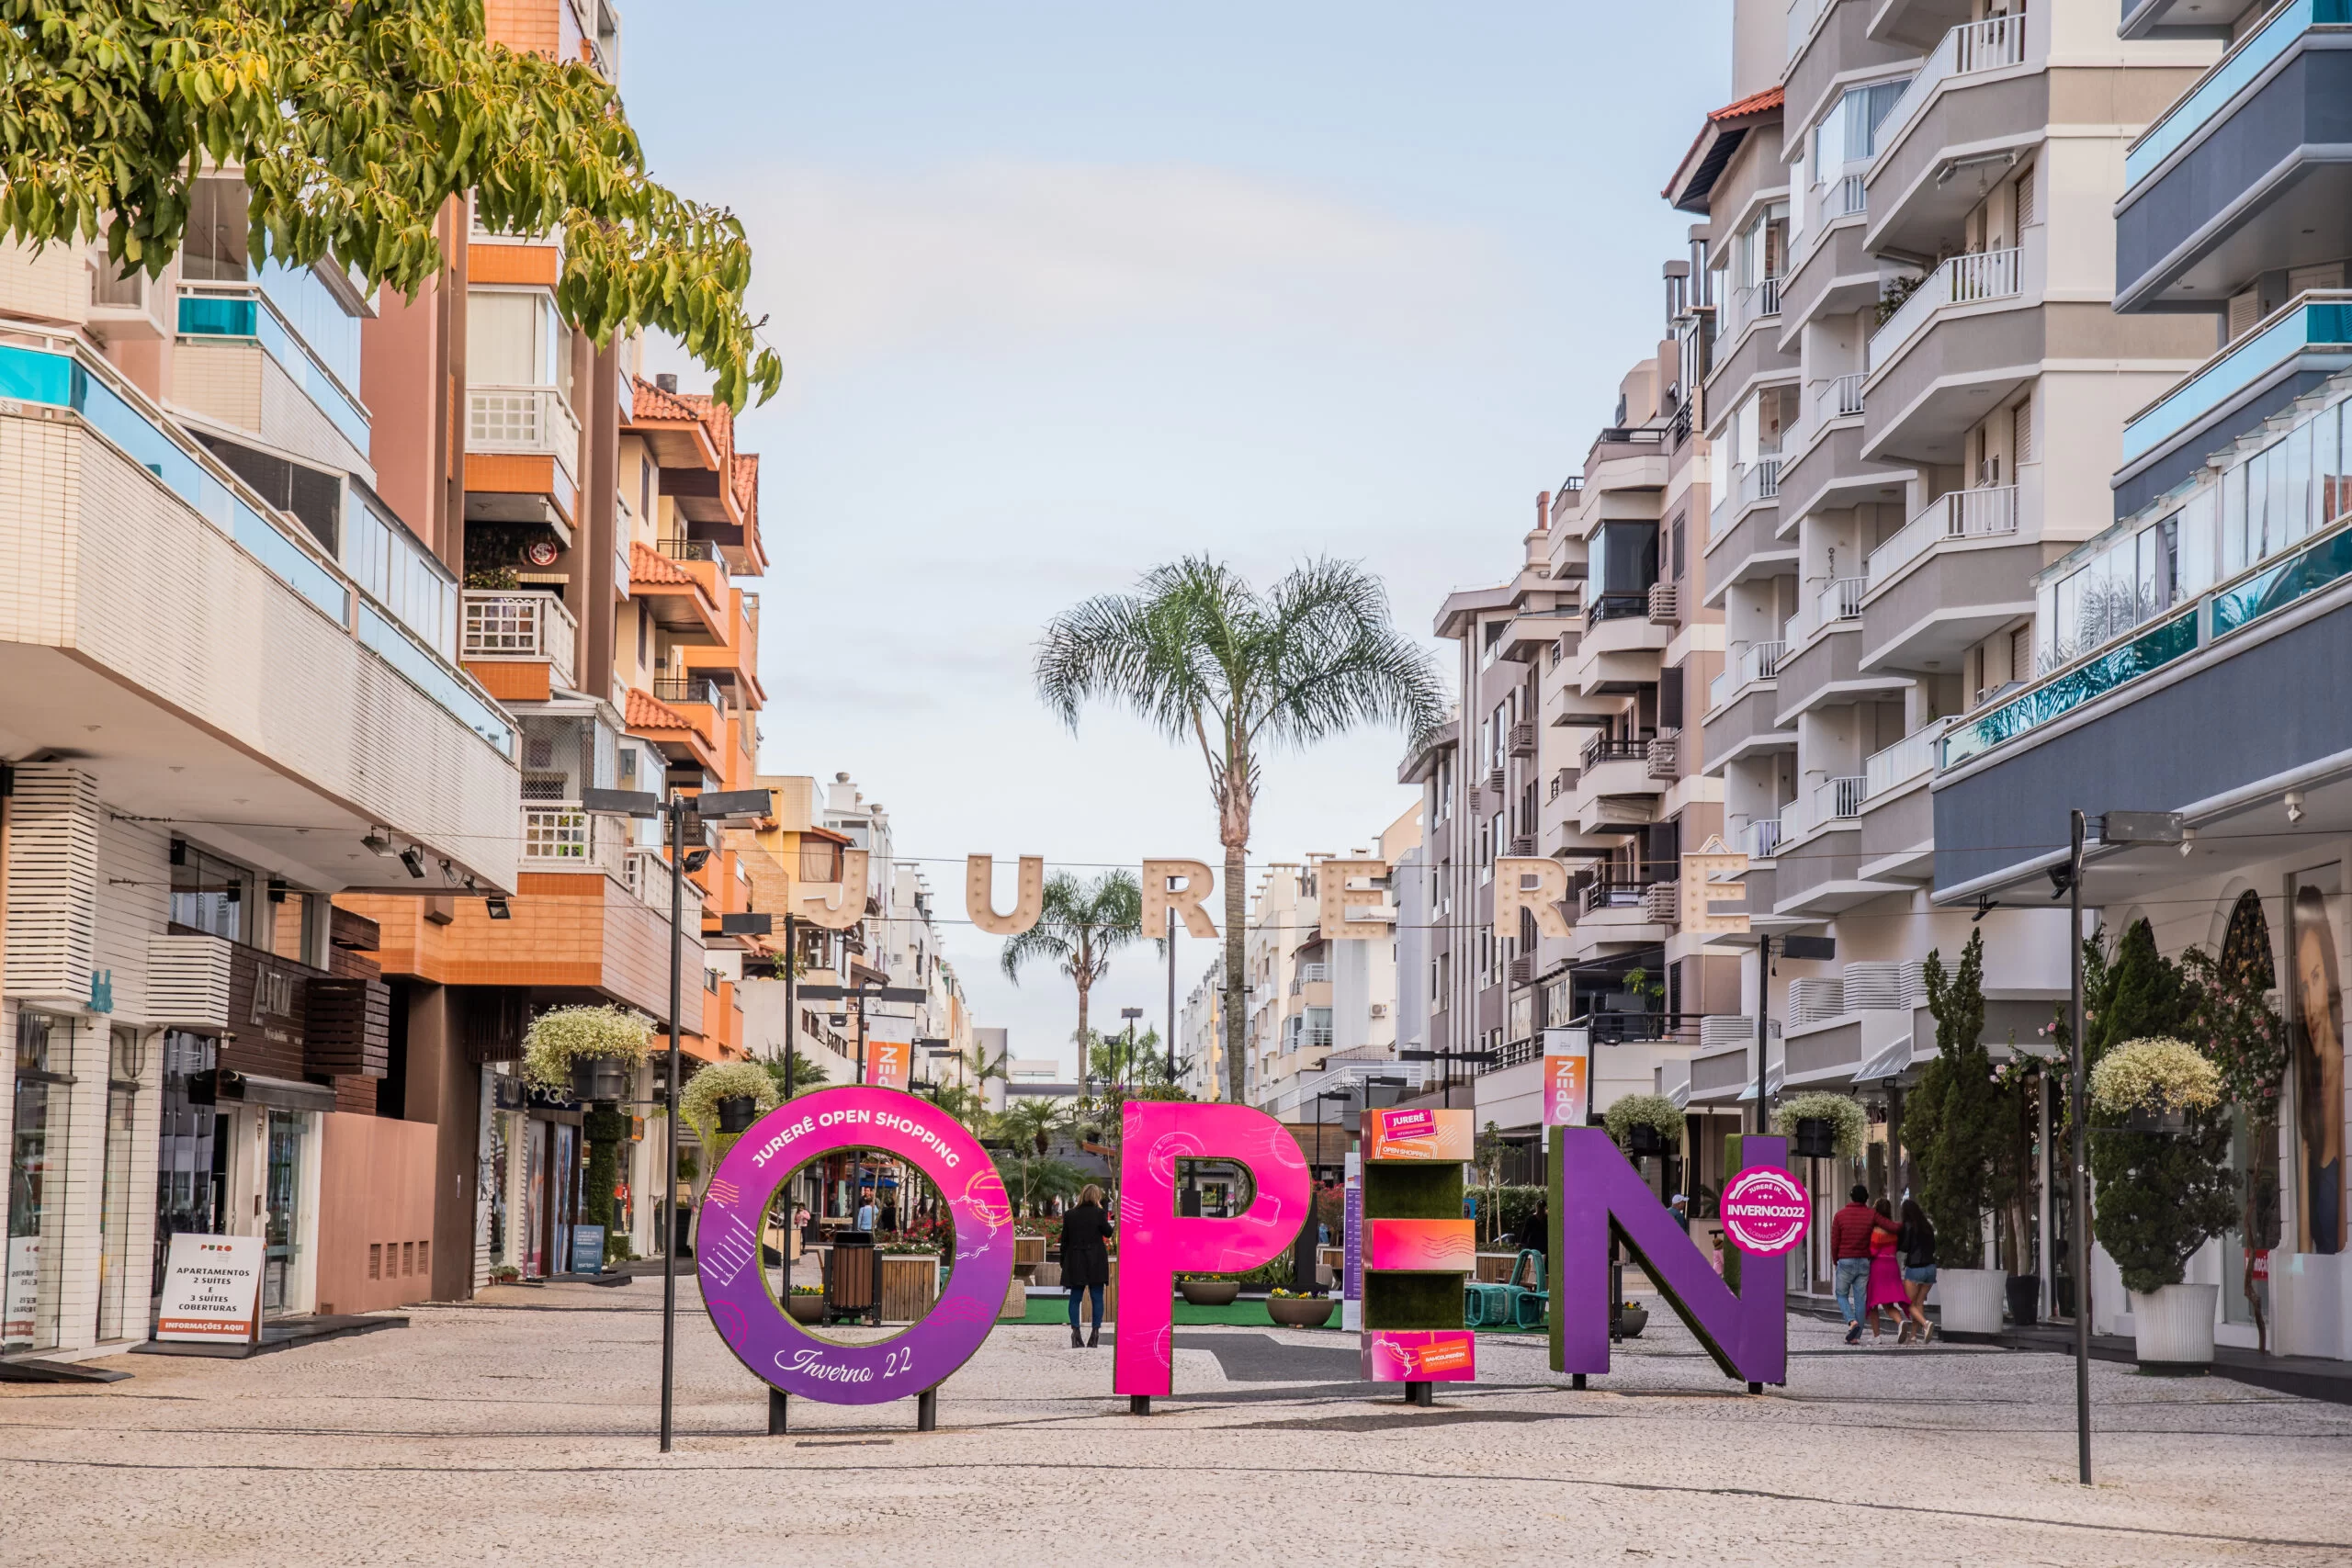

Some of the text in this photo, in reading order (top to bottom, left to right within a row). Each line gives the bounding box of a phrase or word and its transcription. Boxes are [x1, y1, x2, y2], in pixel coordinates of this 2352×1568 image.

[803, 834, 1751, 939] JURERÊ
[877, 1046, 898, 1088] PEN
[1555, 1060, 1575, 1122] OPEN
[1393, 1112, 1425, 1126] JURERÊ
[752, 1110, 960, 1168] JURERÊ OPEN SHOPPING
[1748, 1183, 1772, 1194] JURERÊ
[200, 1244, 232, 1252] PURO
[695, 1085, 1788, 1405] OPEN
[176, 1268, 250, 1277] APARTAMENTOS
[201, 1277, 231, 1285] SUÍTES
[198, 1294, 228, 1303] SUÍTES
[178, 1303, 237, 1312] COBERTURAS
[165, 1322, 243, 1331] INFORMAÇÕES AQUI
[774, 1346, 912, 1382] Inverno 22
